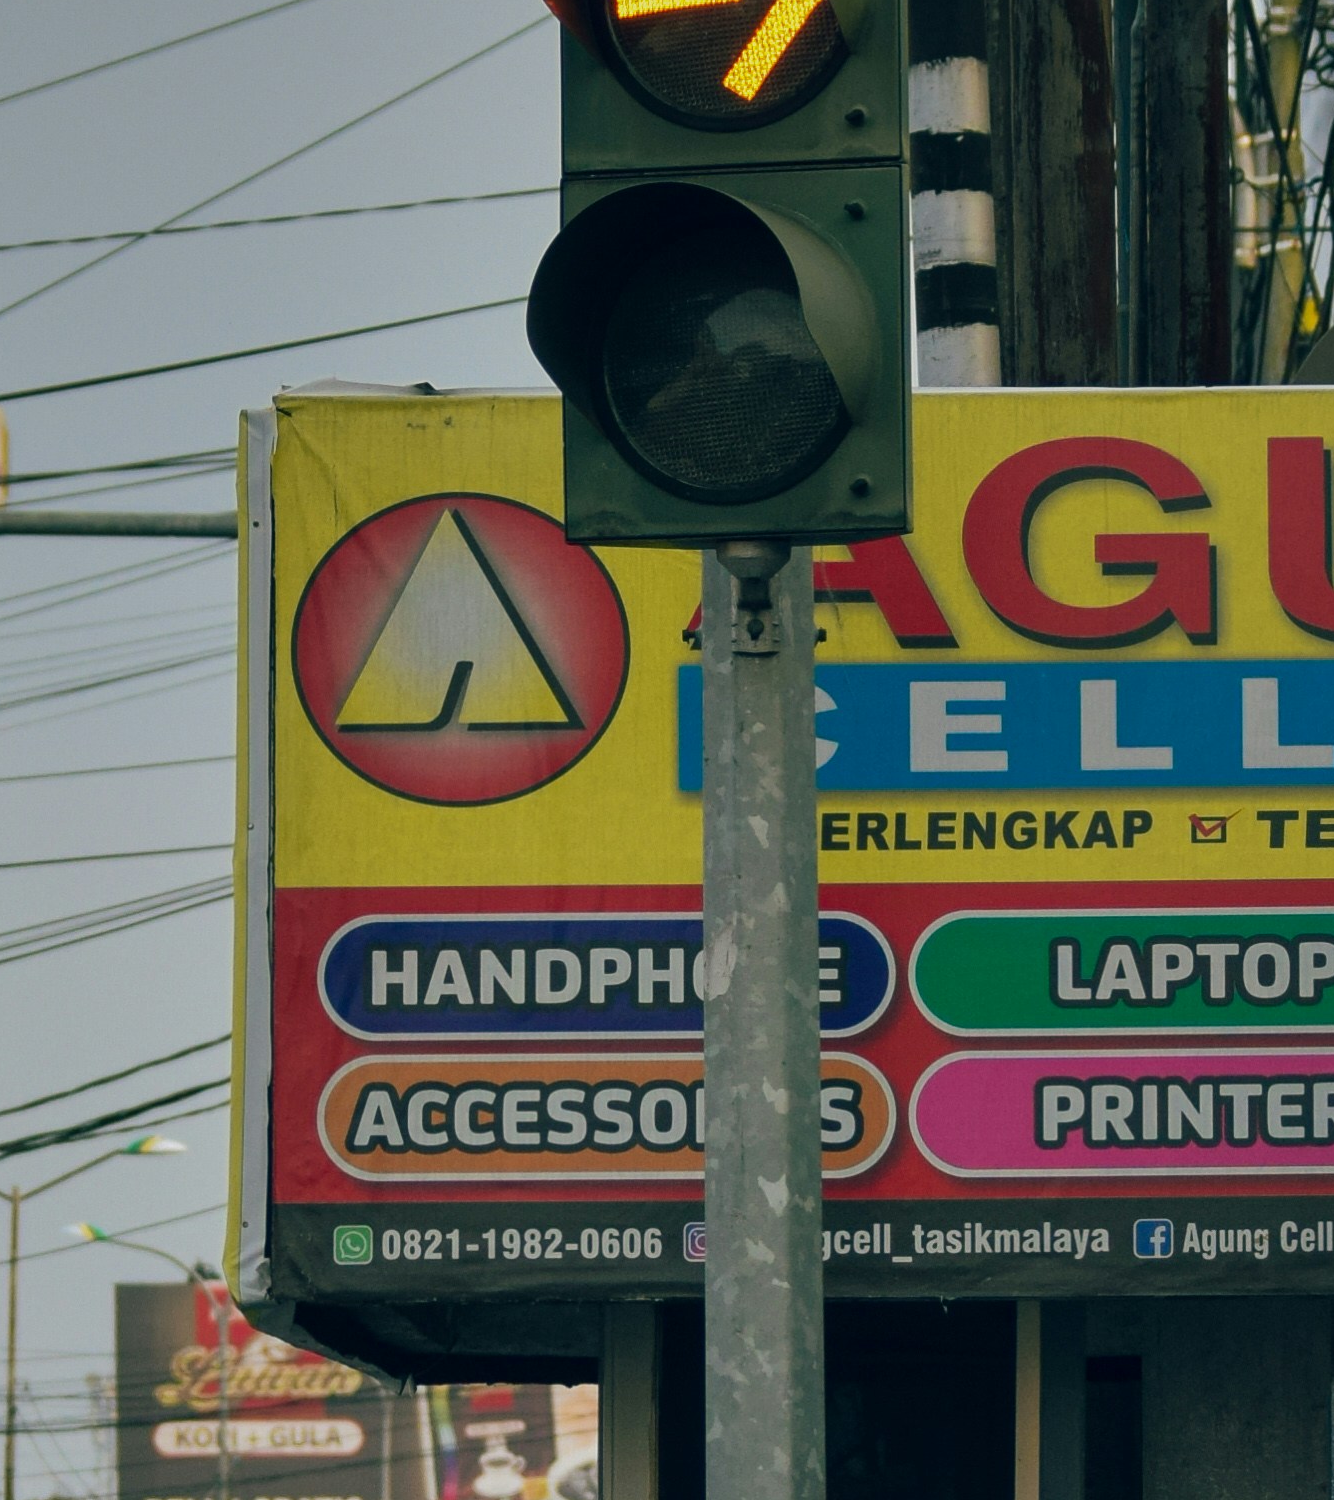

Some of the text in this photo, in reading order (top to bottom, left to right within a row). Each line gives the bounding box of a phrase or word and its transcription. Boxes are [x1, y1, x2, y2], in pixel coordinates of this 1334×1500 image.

[820, 810, 1153, 851] ERLENGKAP
[372, 946, 840, 1005] HANDPHE
[382, 1227, 662, 1260] 0821-1982-0606
[1183, 1222, 1269, 1260] Agung
[269, 1425, 343, 1446] GULA
